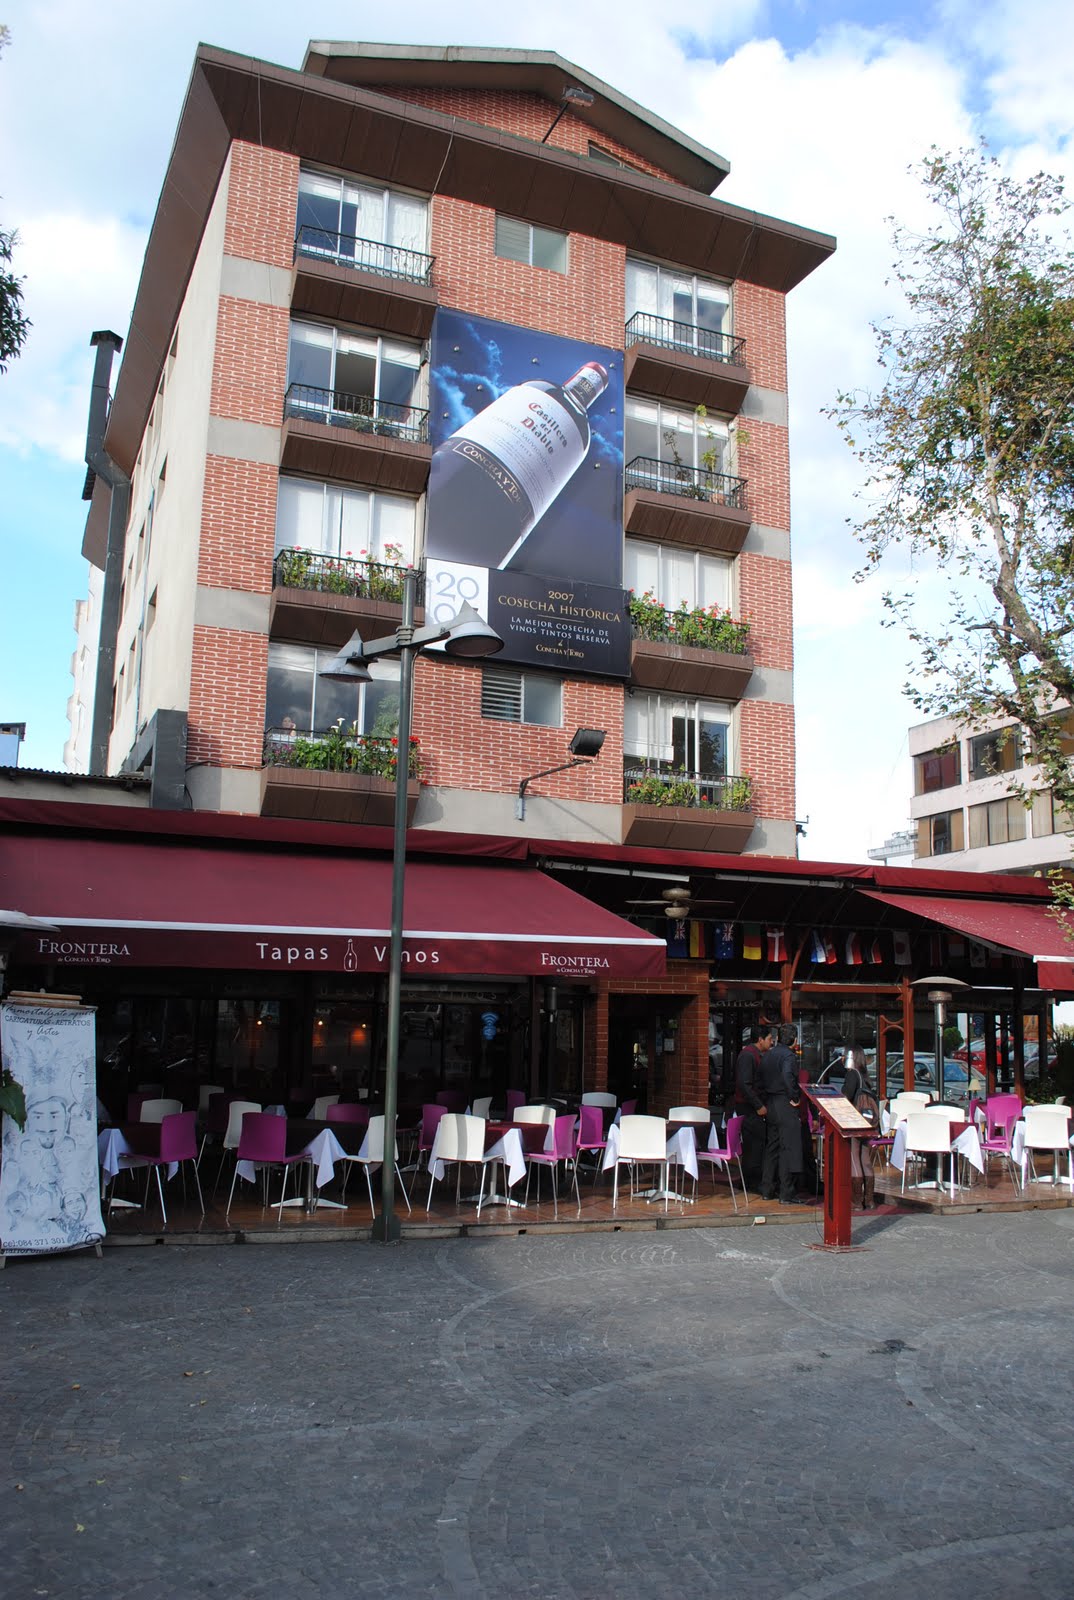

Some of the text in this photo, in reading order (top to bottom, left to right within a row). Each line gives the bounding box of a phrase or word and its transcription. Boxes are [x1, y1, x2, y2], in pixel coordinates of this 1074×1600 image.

[528, 402, 567, 447] Casillero
[540, 423, 551, 434] del
[521, 416, 554, 455] Diablo
[463, 445, 502, 479] CONCHA
[503, 477, 510, 486] Y
[435, 571, 480, 602] 20
[548, 590, 575, 604] 2007
[498, 595, 621, 623] COSECHA HISTÓRICA
[509, 623, 611, 645] VINOS TINTOS RESERVA
[511, 616, 609, 637] LA MEJOR COSECHA DE
[38, 938, 131, 956] FRONTERA
[255, 942, 329, 964] Tapas
[373, 946, 440, 963] Vnos
[541, 952, 610, 968] FRONTERA
[55, 1019, 91, 1027] RETRATOS
[51, 1237, 65, 1245] 301
